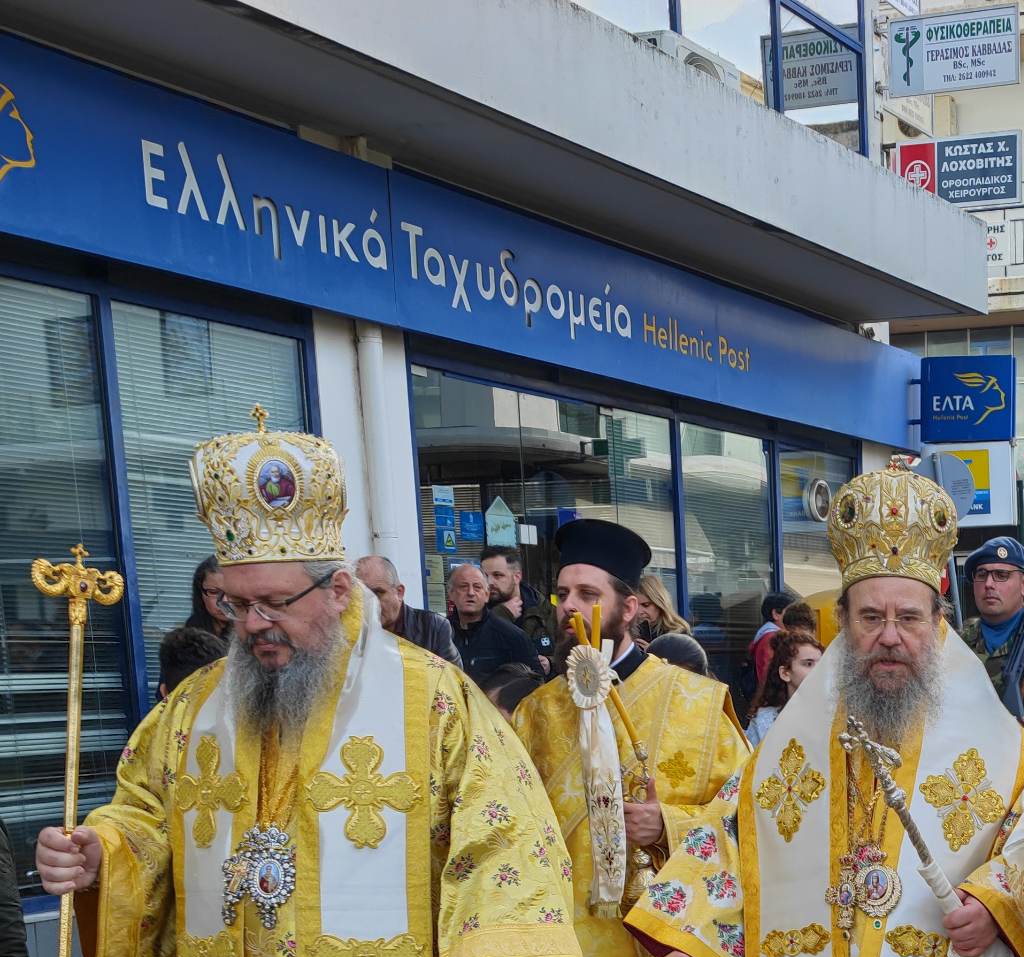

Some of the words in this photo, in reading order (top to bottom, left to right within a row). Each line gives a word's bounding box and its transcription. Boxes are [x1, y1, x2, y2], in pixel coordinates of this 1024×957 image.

[926, 18, 1012, 42] ΦΥΣΙΚΟΘΕΡΑΠΕΙΑ
[926, 46, 969, 62] ΓΕΡΑΣΙΜΟΣ
[972, 41, 1012, 57] ΚΑΒΒΑΔΑΣ
[953, 60, 969, 70] BSc,
[971, 58, 986, 67] MSc
[944, 143, 994, 157] ΚΩΣΤΑΣ
[998, 141, 1010, 152] Χ.
[941, 156, 1014, 173] ΛΟΧΟΒΙΤΗΣ
[941, 174, 1014, 189] ΟΡΘΟΠΑΙΔΙΚΟΣ
[948, 186, 1006, 199] ΧΕΙΡΟΥΡΓΟΣ
[141, 139, 388, 271] Ελληνικά
[400, 221, 633, 341] Ταχυδρομεία
[643, 312, 713, 362] Hellenic
[718, 335, 752, 372] Post
[932, 395, 975, 412] ΕΛΤΑ
